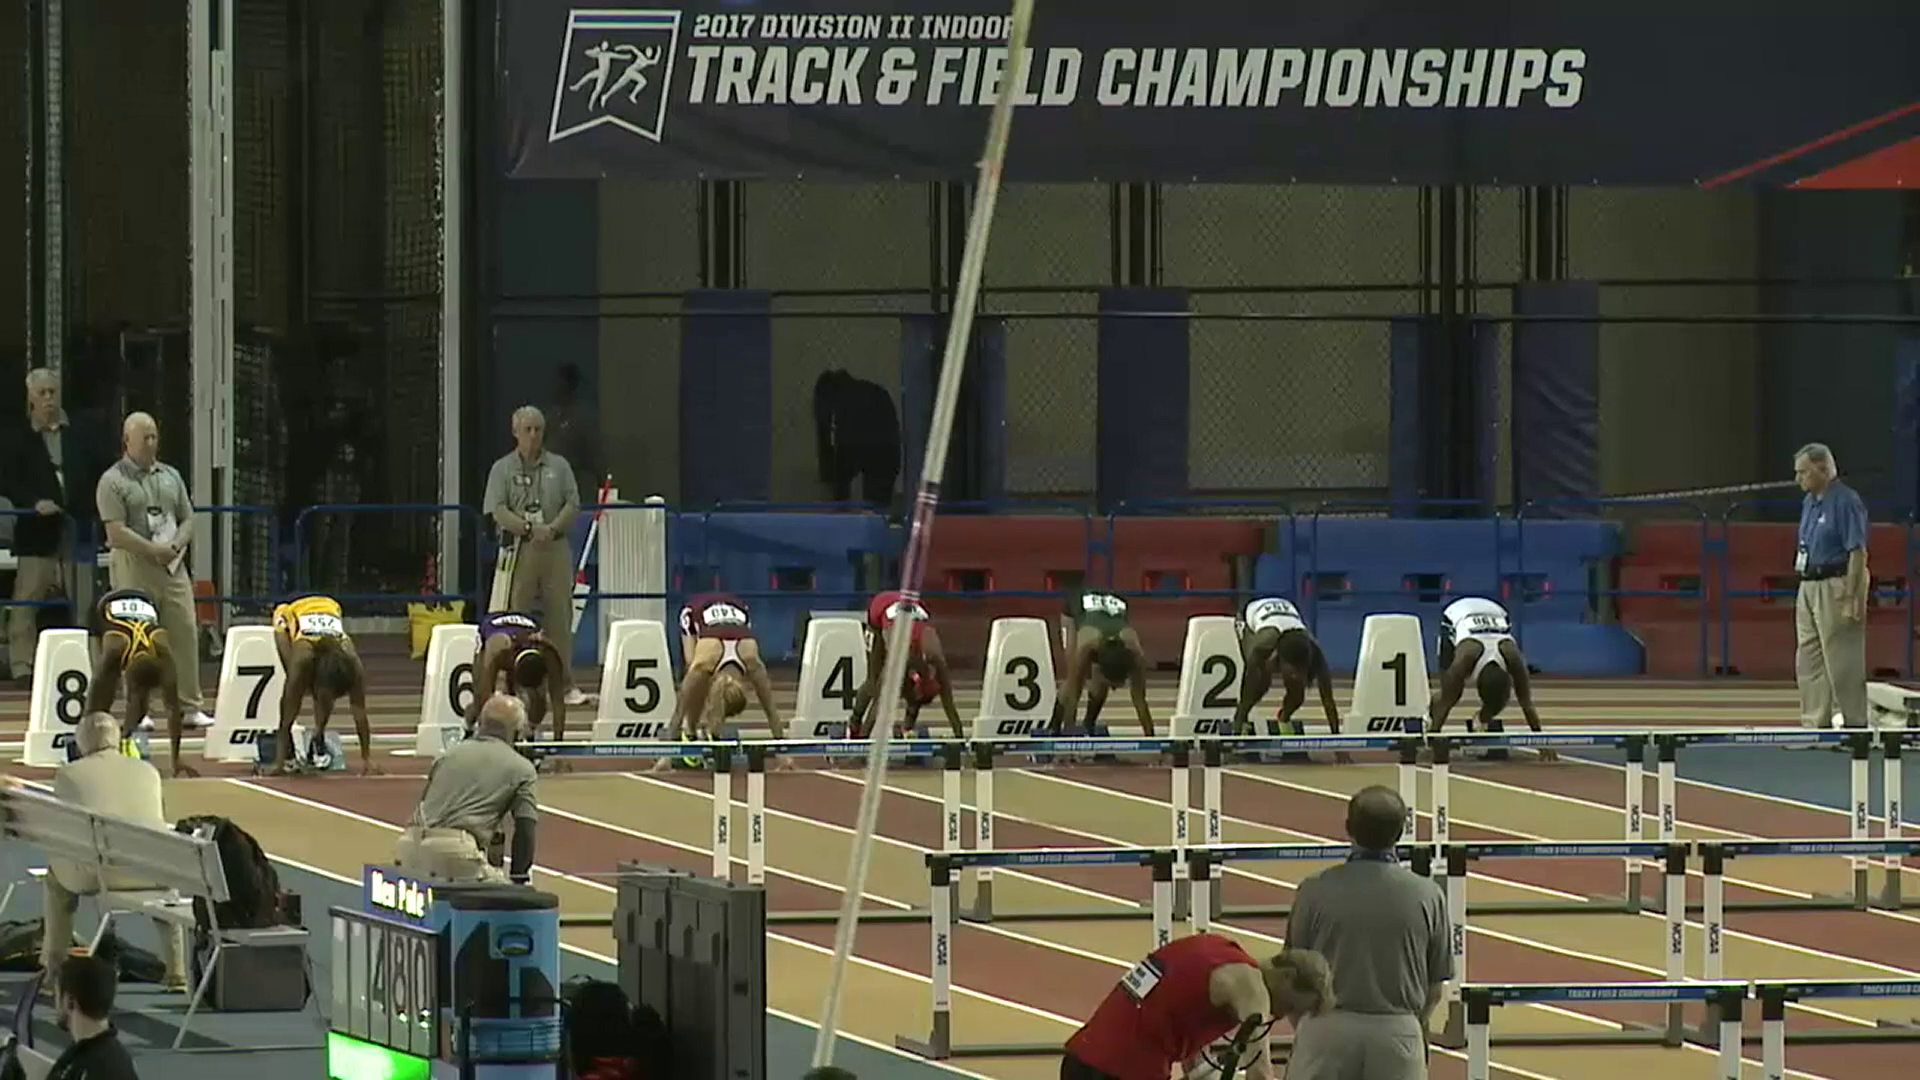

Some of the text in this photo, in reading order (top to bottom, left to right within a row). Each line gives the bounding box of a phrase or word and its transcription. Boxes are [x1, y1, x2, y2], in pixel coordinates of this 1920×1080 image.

[693, 14, 755, 39] 2017
[760, 14, 882, 39] DIVISION
[887, 15, 913, 39] II
[686, 46, 1586, 108] TRACK & FIELD CHAMPIONSHIPS
[56, 670, 87, 724] 8
[237, 665, 275, 719] 7
[449, 663, 474, 718] 6
[624, 658, 661, 714] 5
[822, 656, 857, 711] 4
[1004, 656, 1041, 711] 3
[1201, 654, 1237, 708] 2
[1381, 652, 1407, 707] 1
[1367, 717, 1404, 732] GIL
